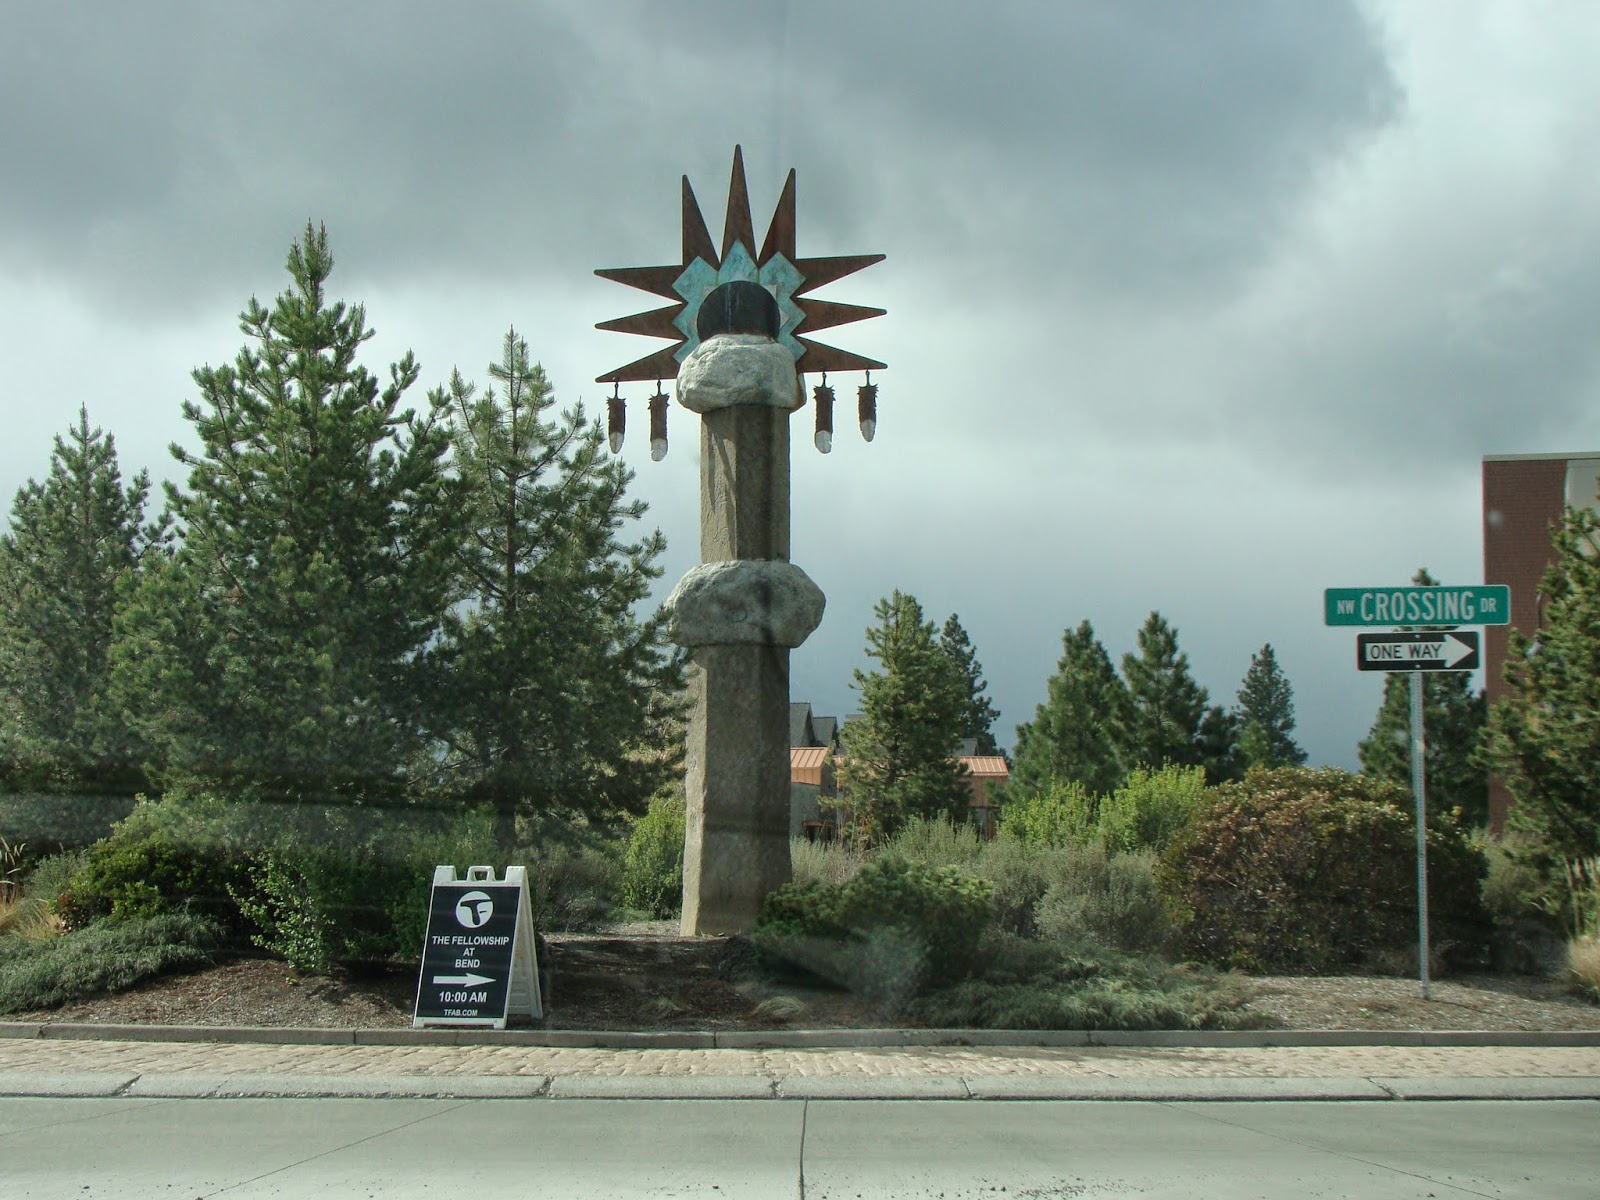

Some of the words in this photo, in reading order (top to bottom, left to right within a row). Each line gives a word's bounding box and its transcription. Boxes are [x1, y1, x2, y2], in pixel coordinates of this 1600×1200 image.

[1337, 599, 1355, 615] NW
[1361, 591, 1475, 622] CROSSING
[1480, 598, 1497, 613] DR
[1370, 645, 1402, 659] ONE
[1408, 644, 1442, 658] WAY
[432, 936, 450, 945] THE
[452, 936, 509, 945] FELLOWSHIP
[463, 948, 475, 956] AT
[455, 959, 480, 968] BEND
[439, 991, 468, 1002] 10:00
[469, 992, 487, 1003] AM
